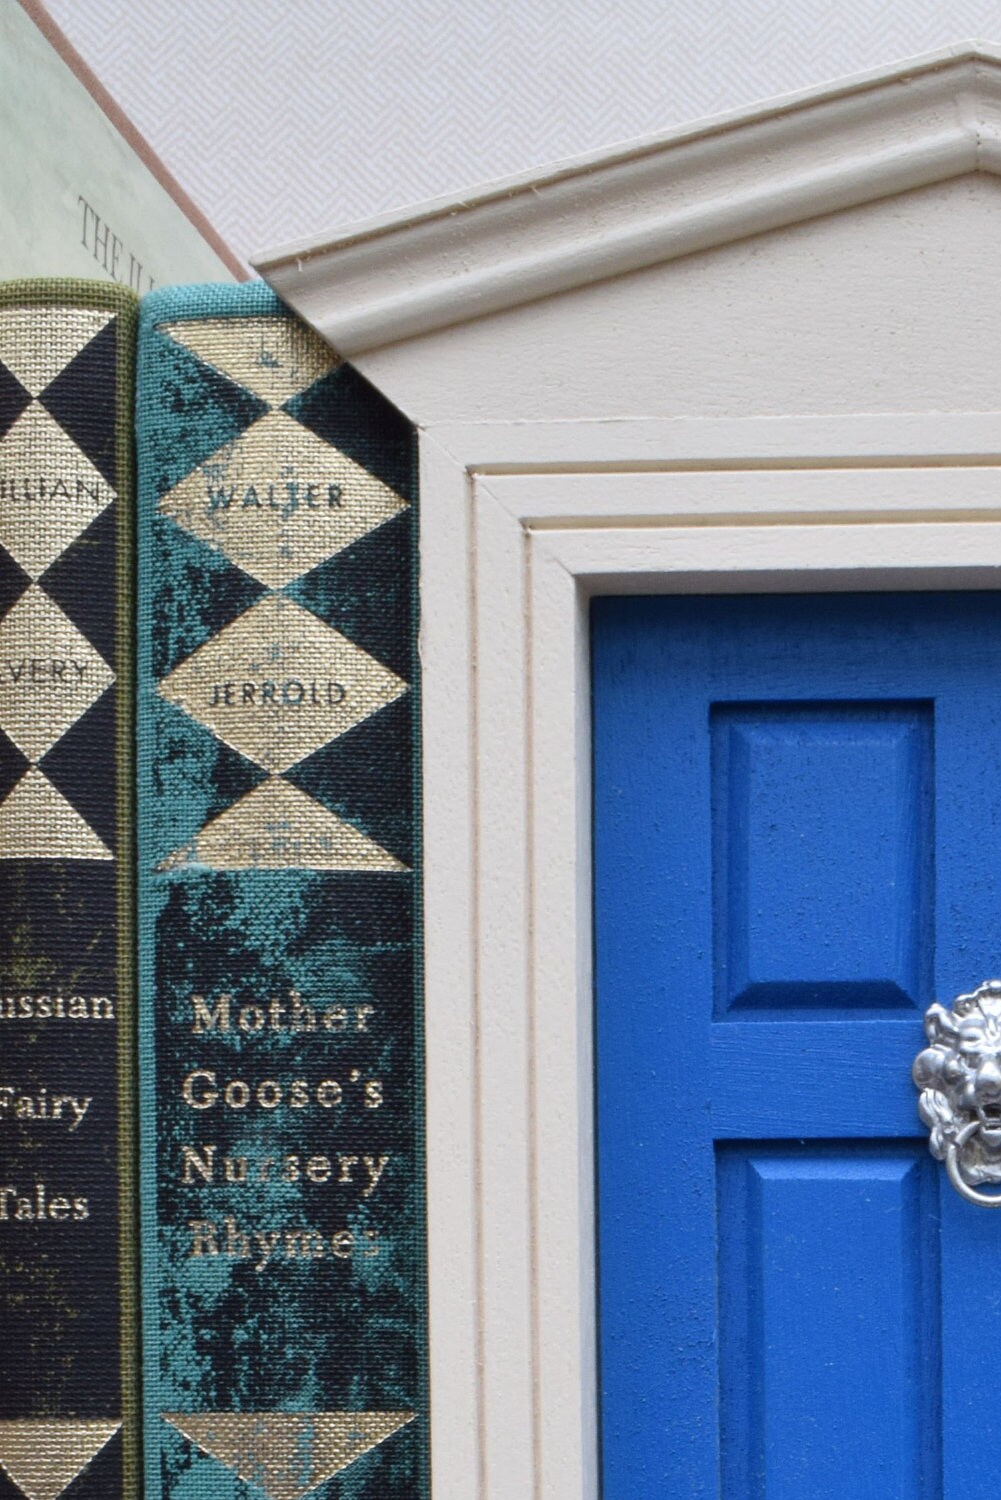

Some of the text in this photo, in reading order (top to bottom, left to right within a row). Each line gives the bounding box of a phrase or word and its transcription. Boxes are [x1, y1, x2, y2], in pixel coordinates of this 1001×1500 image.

[78, 195, 123, 282] THE
[207, 482, 344, 509] WALTER
[209, 679, 347, 706] JERROLD
[191, 990, 376, 1033] Mother
[181, 1069, 384, 1110] Goose's
[180, 1145, 390, 1197] Nursery
[188, 1215, 380, 1272] Rhymes
